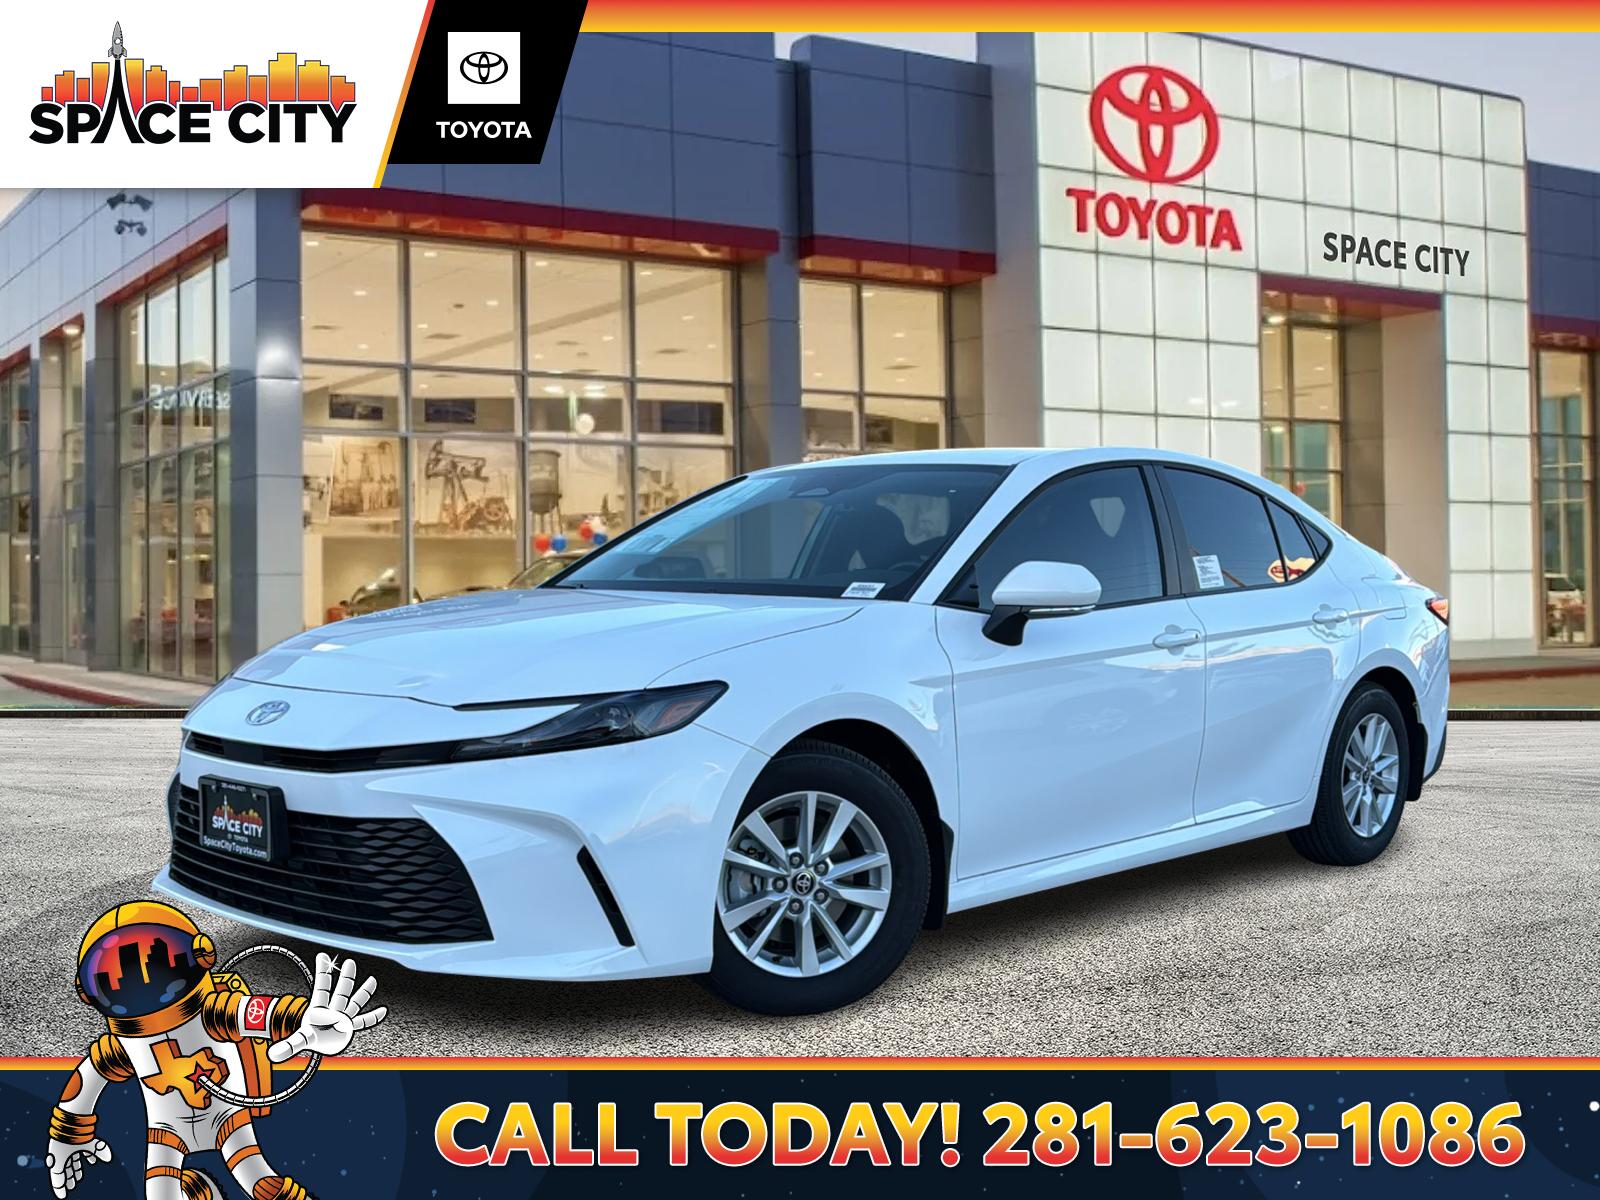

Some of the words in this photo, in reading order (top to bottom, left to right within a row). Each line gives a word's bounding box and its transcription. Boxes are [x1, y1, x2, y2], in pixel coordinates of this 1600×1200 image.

[1066, 188, 1242, 251] TOYOTA
[1323, 232, 1407, 270] SPACE
[1415, 245, 1470, 277] CITY
[212, 815, 241, 834] SPACE
[242, 822, 263, 838] CITY
[203, 835, 267, 859] SpaceCityToyota.com
